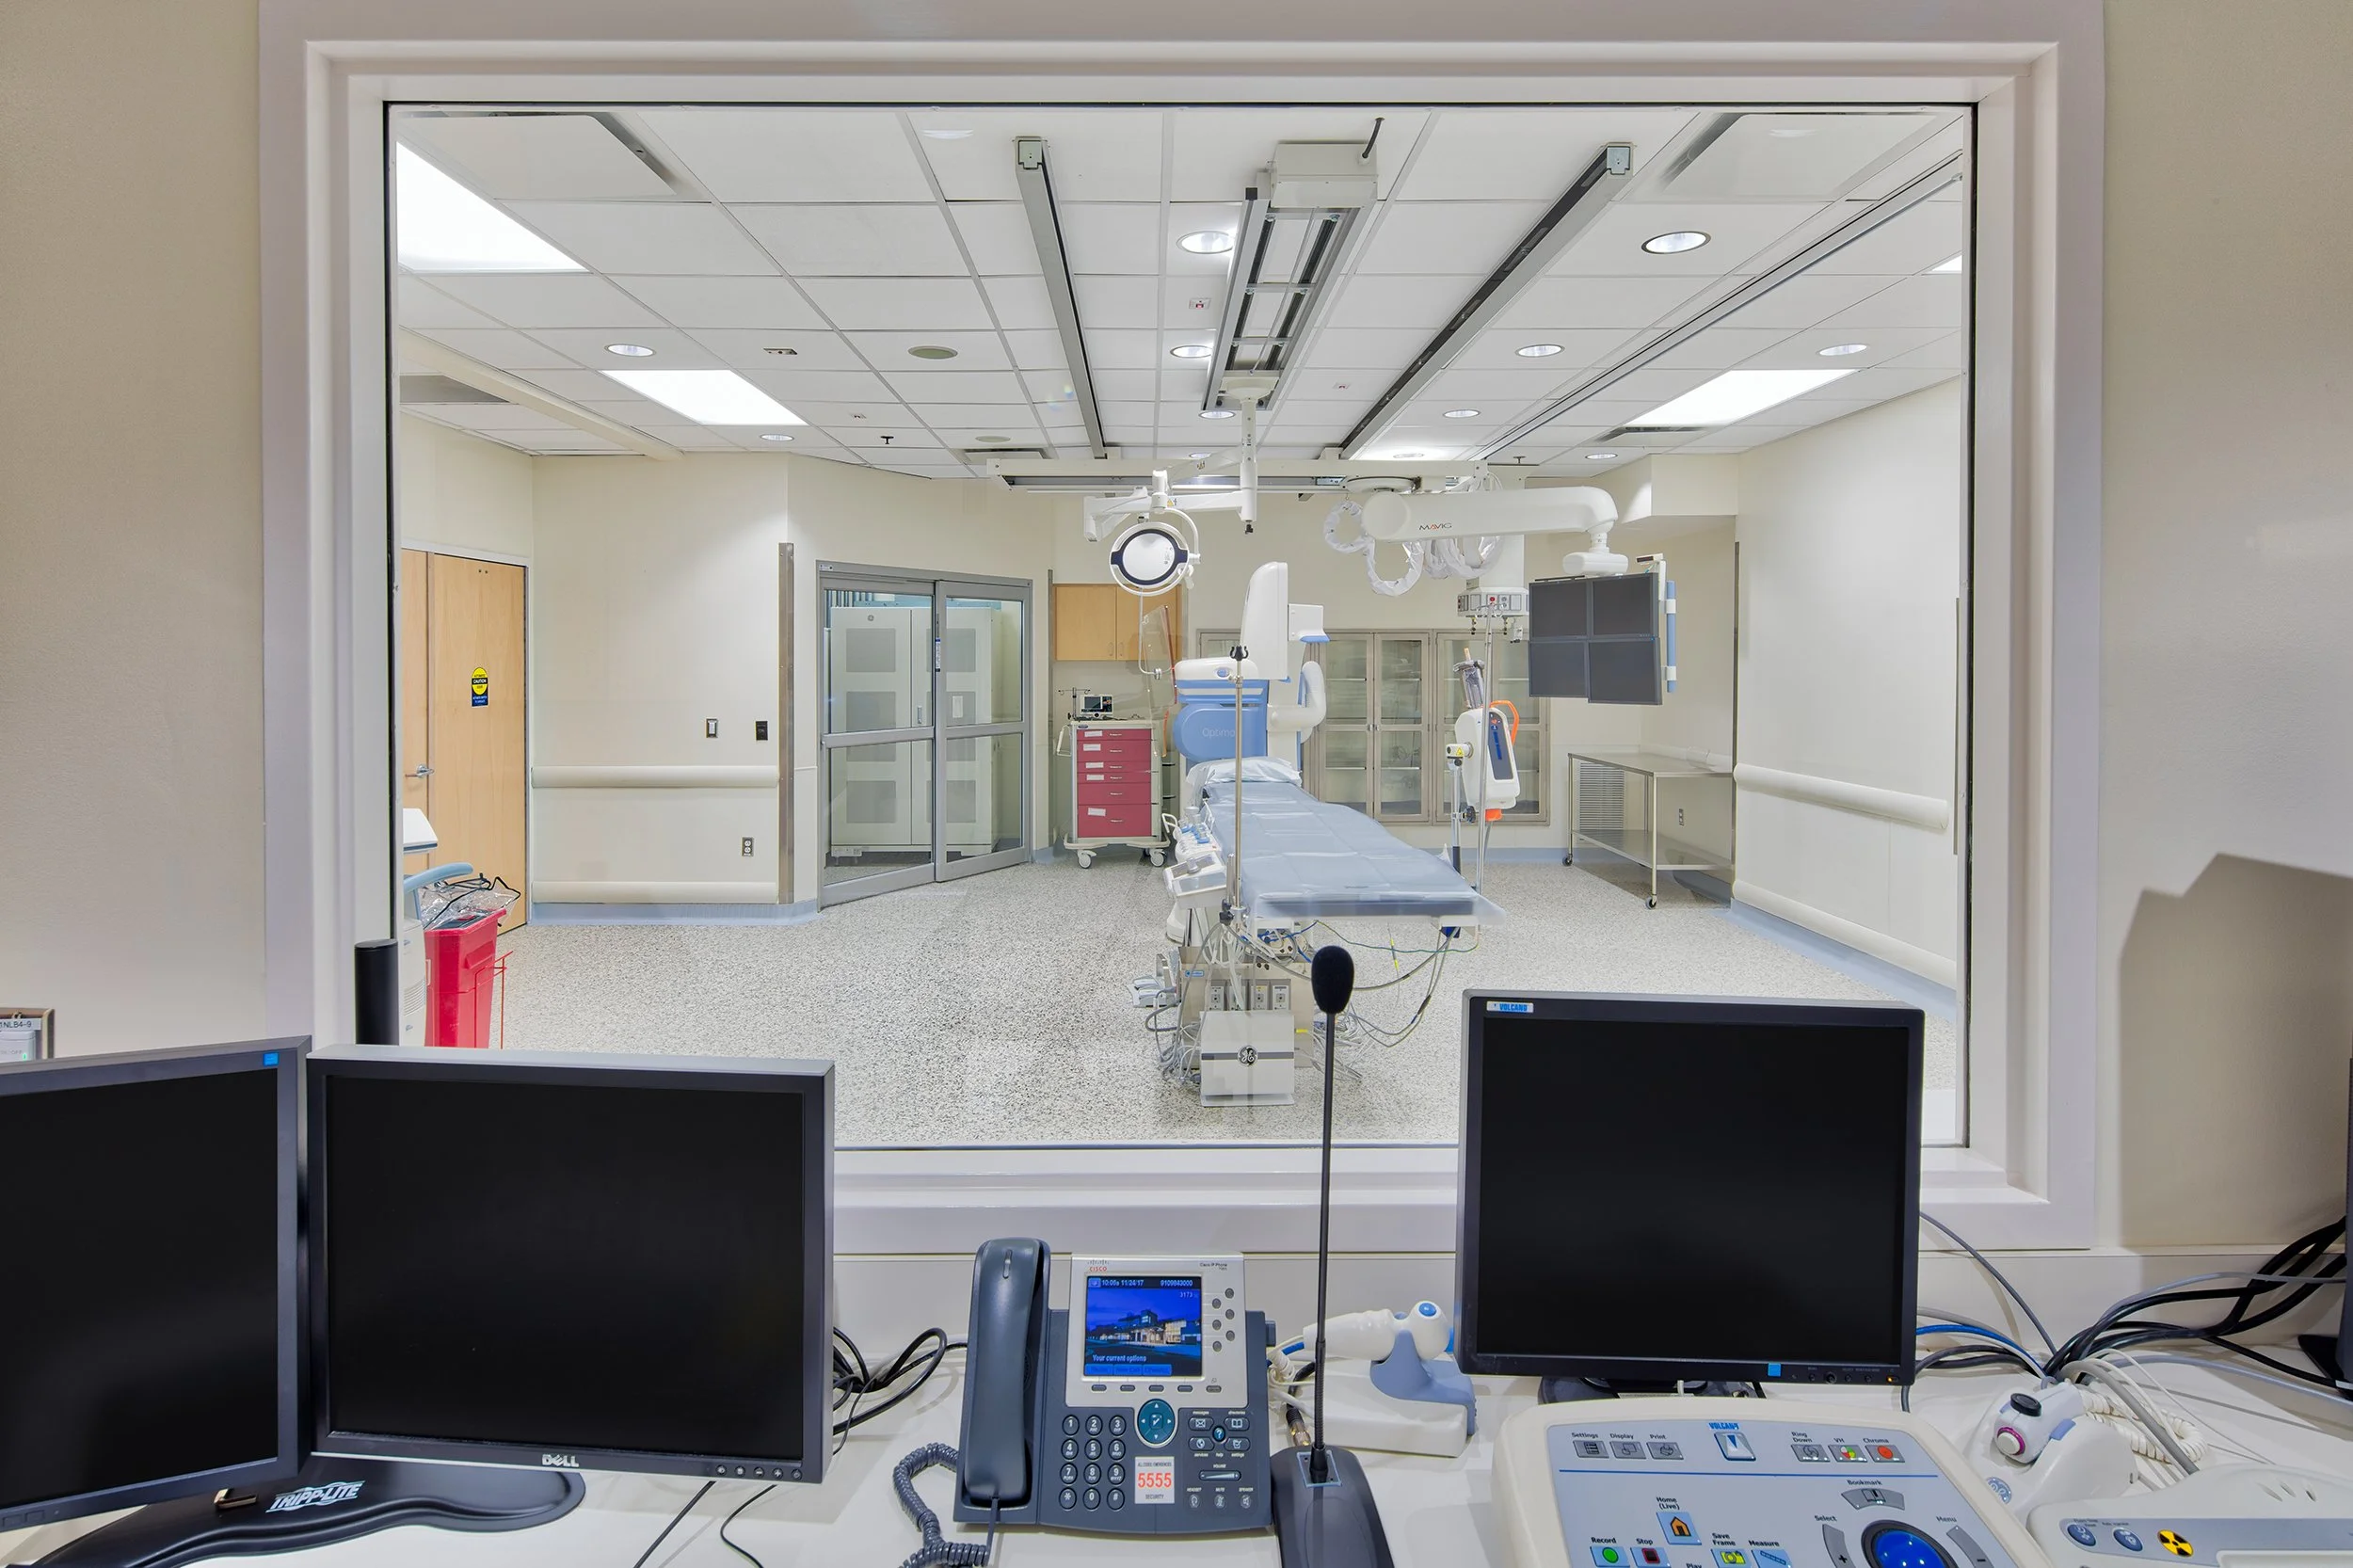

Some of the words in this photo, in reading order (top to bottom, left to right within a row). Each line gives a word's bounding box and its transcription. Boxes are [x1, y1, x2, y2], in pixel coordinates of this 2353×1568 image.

[1418, 522, 1452, 530] MAVIG
[1499, 1003, 1528, 1011] VOLCANO
[542, 1454, 579, 1467] DELL
[1138, 1473, 1172, 1488] 5555
[1089, 1493, 1094, 1501] 0
